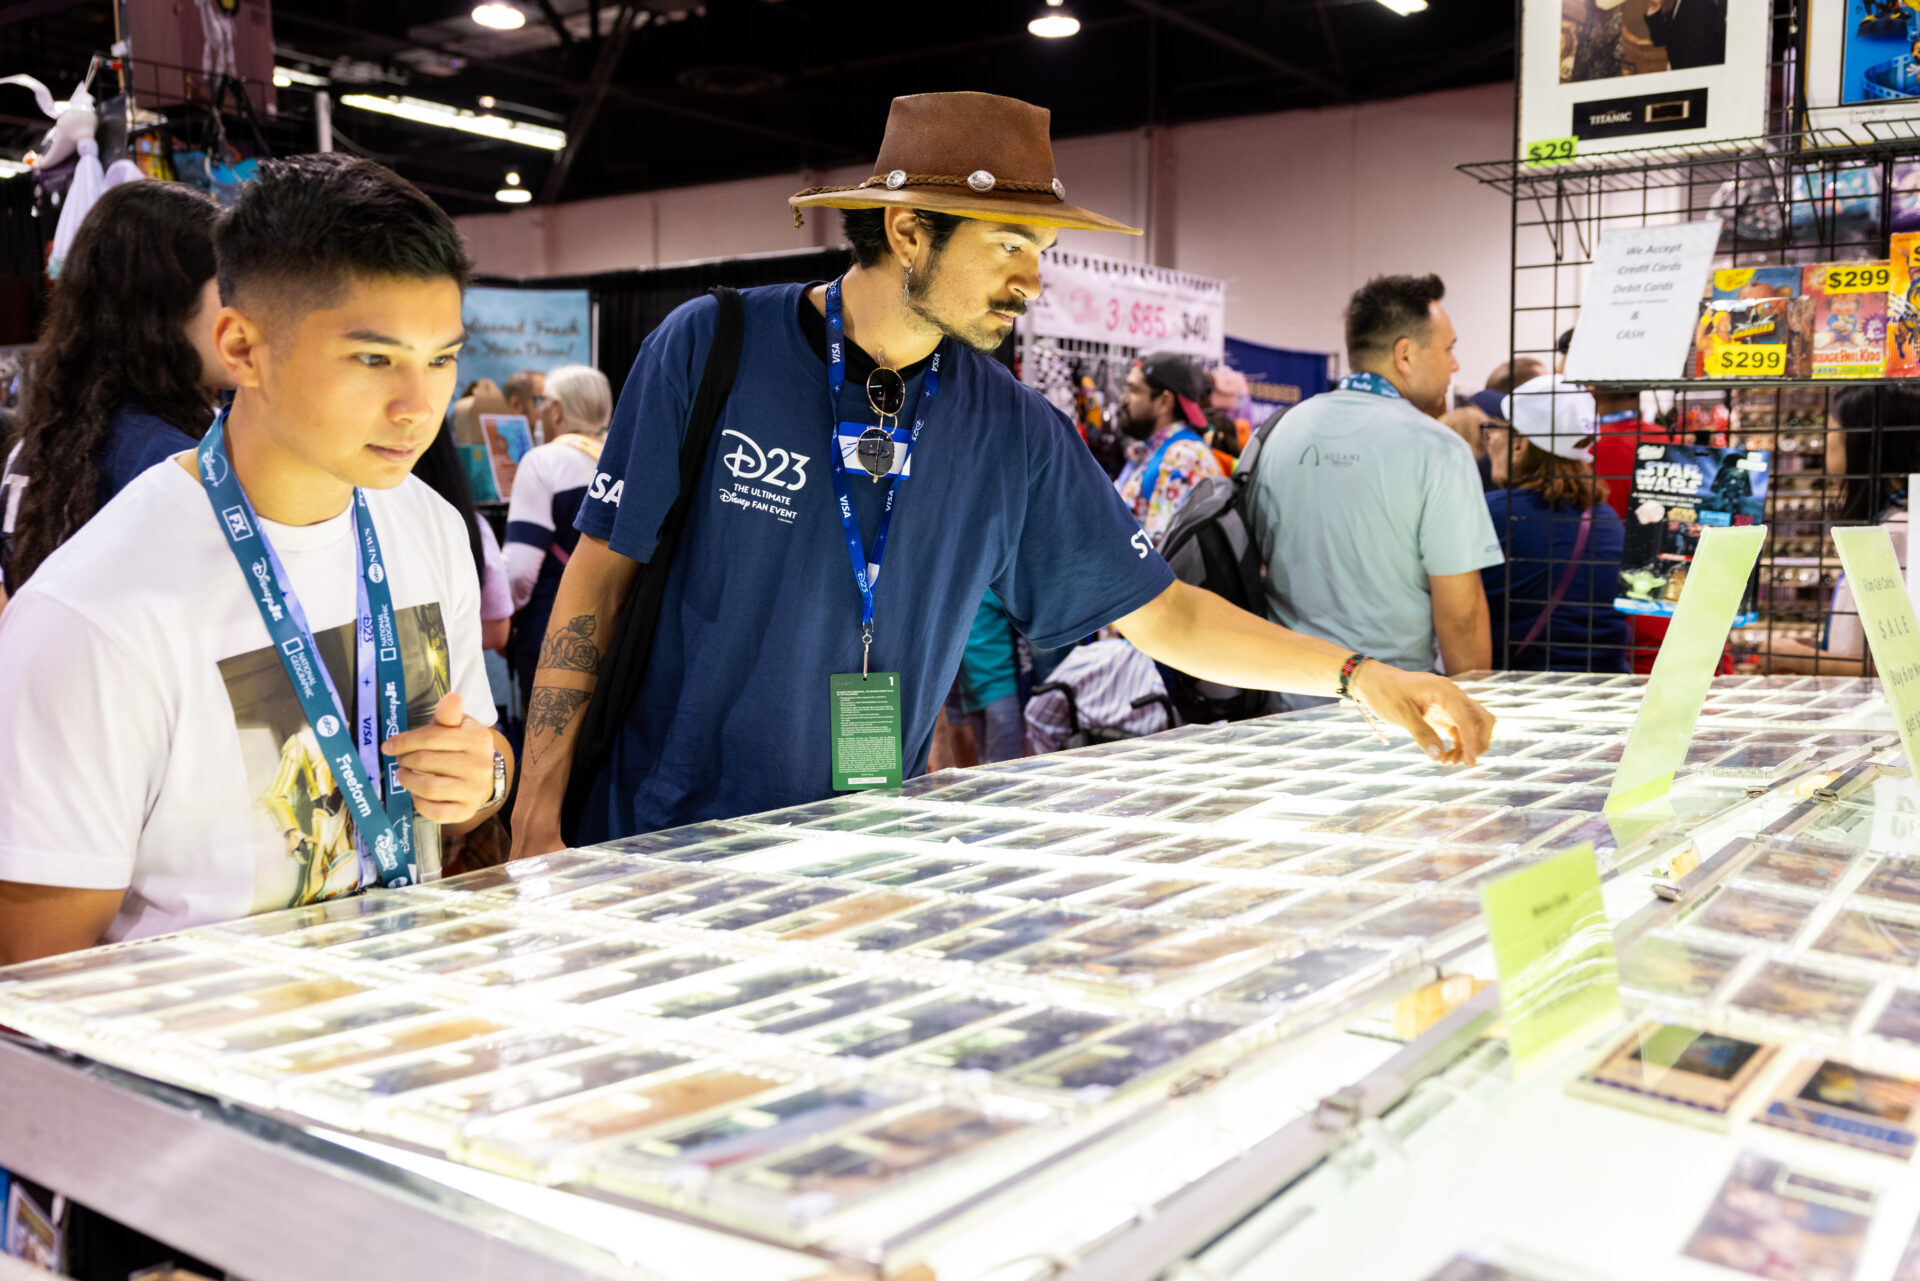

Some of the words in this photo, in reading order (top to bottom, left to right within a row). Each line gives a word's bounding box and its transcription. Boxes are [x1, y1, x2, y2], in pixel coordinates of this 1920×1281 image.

[1589, 111, 1632, 126] TITANIC
[1529, 140, 1574, 165] $29
[1626, 247, 1642, 256] We
[1645, 243, 1683, 255] Accept
[1618, 264, 1649, 275] Credit
[1651, 261, 1682, 273] Cards
[1828, 268, 1889, 290] $299
[1612, 283, 1642, 294] Debit
[1643, 281, 1674, 292] Cards
[1630, 311, 1640, 321] &
[1615, 329, 1646, 341] CASH
[832, 343, 841, 364] VISA
[931, 353, 940, 372] VISA
[1720, 351, 1780, 369] $299
[201, 446, 219, 488] Disney+
[722, 429, 811, 491] D23
[1635, 461, 1703, 480] STAR
[734, 483, 749, 494] THE
[751, 487, 792, 506] ULTIMATE
[1636, 476, 1703, 494] WARS
[719, 488, 750, 511] Disney
[751, 500, 769, 512] FAN
[769, 505, 798, 520] EVENT
[839, 494, 851, 519] VISA
[885, 489, 894, 512] VISA
[229, 513, 247, 534] FX
[364, 526, 378, 562] NEWS
[858, 569, 868, 593] D23
[378, 614, 386, 646] NATIONAL
[382, 604, 393, 646] GEOGRAPHIC
[1878, 615, 1910, 640] SALE
[290, 655, 314, 699] GEOGRAPHIC
[298, 652, 316, 686] NATIONAL
[889, 676, 894, 687] 1
[363, 716, 371, 746] VISA
[336, 753, 372, 818] Freeform
